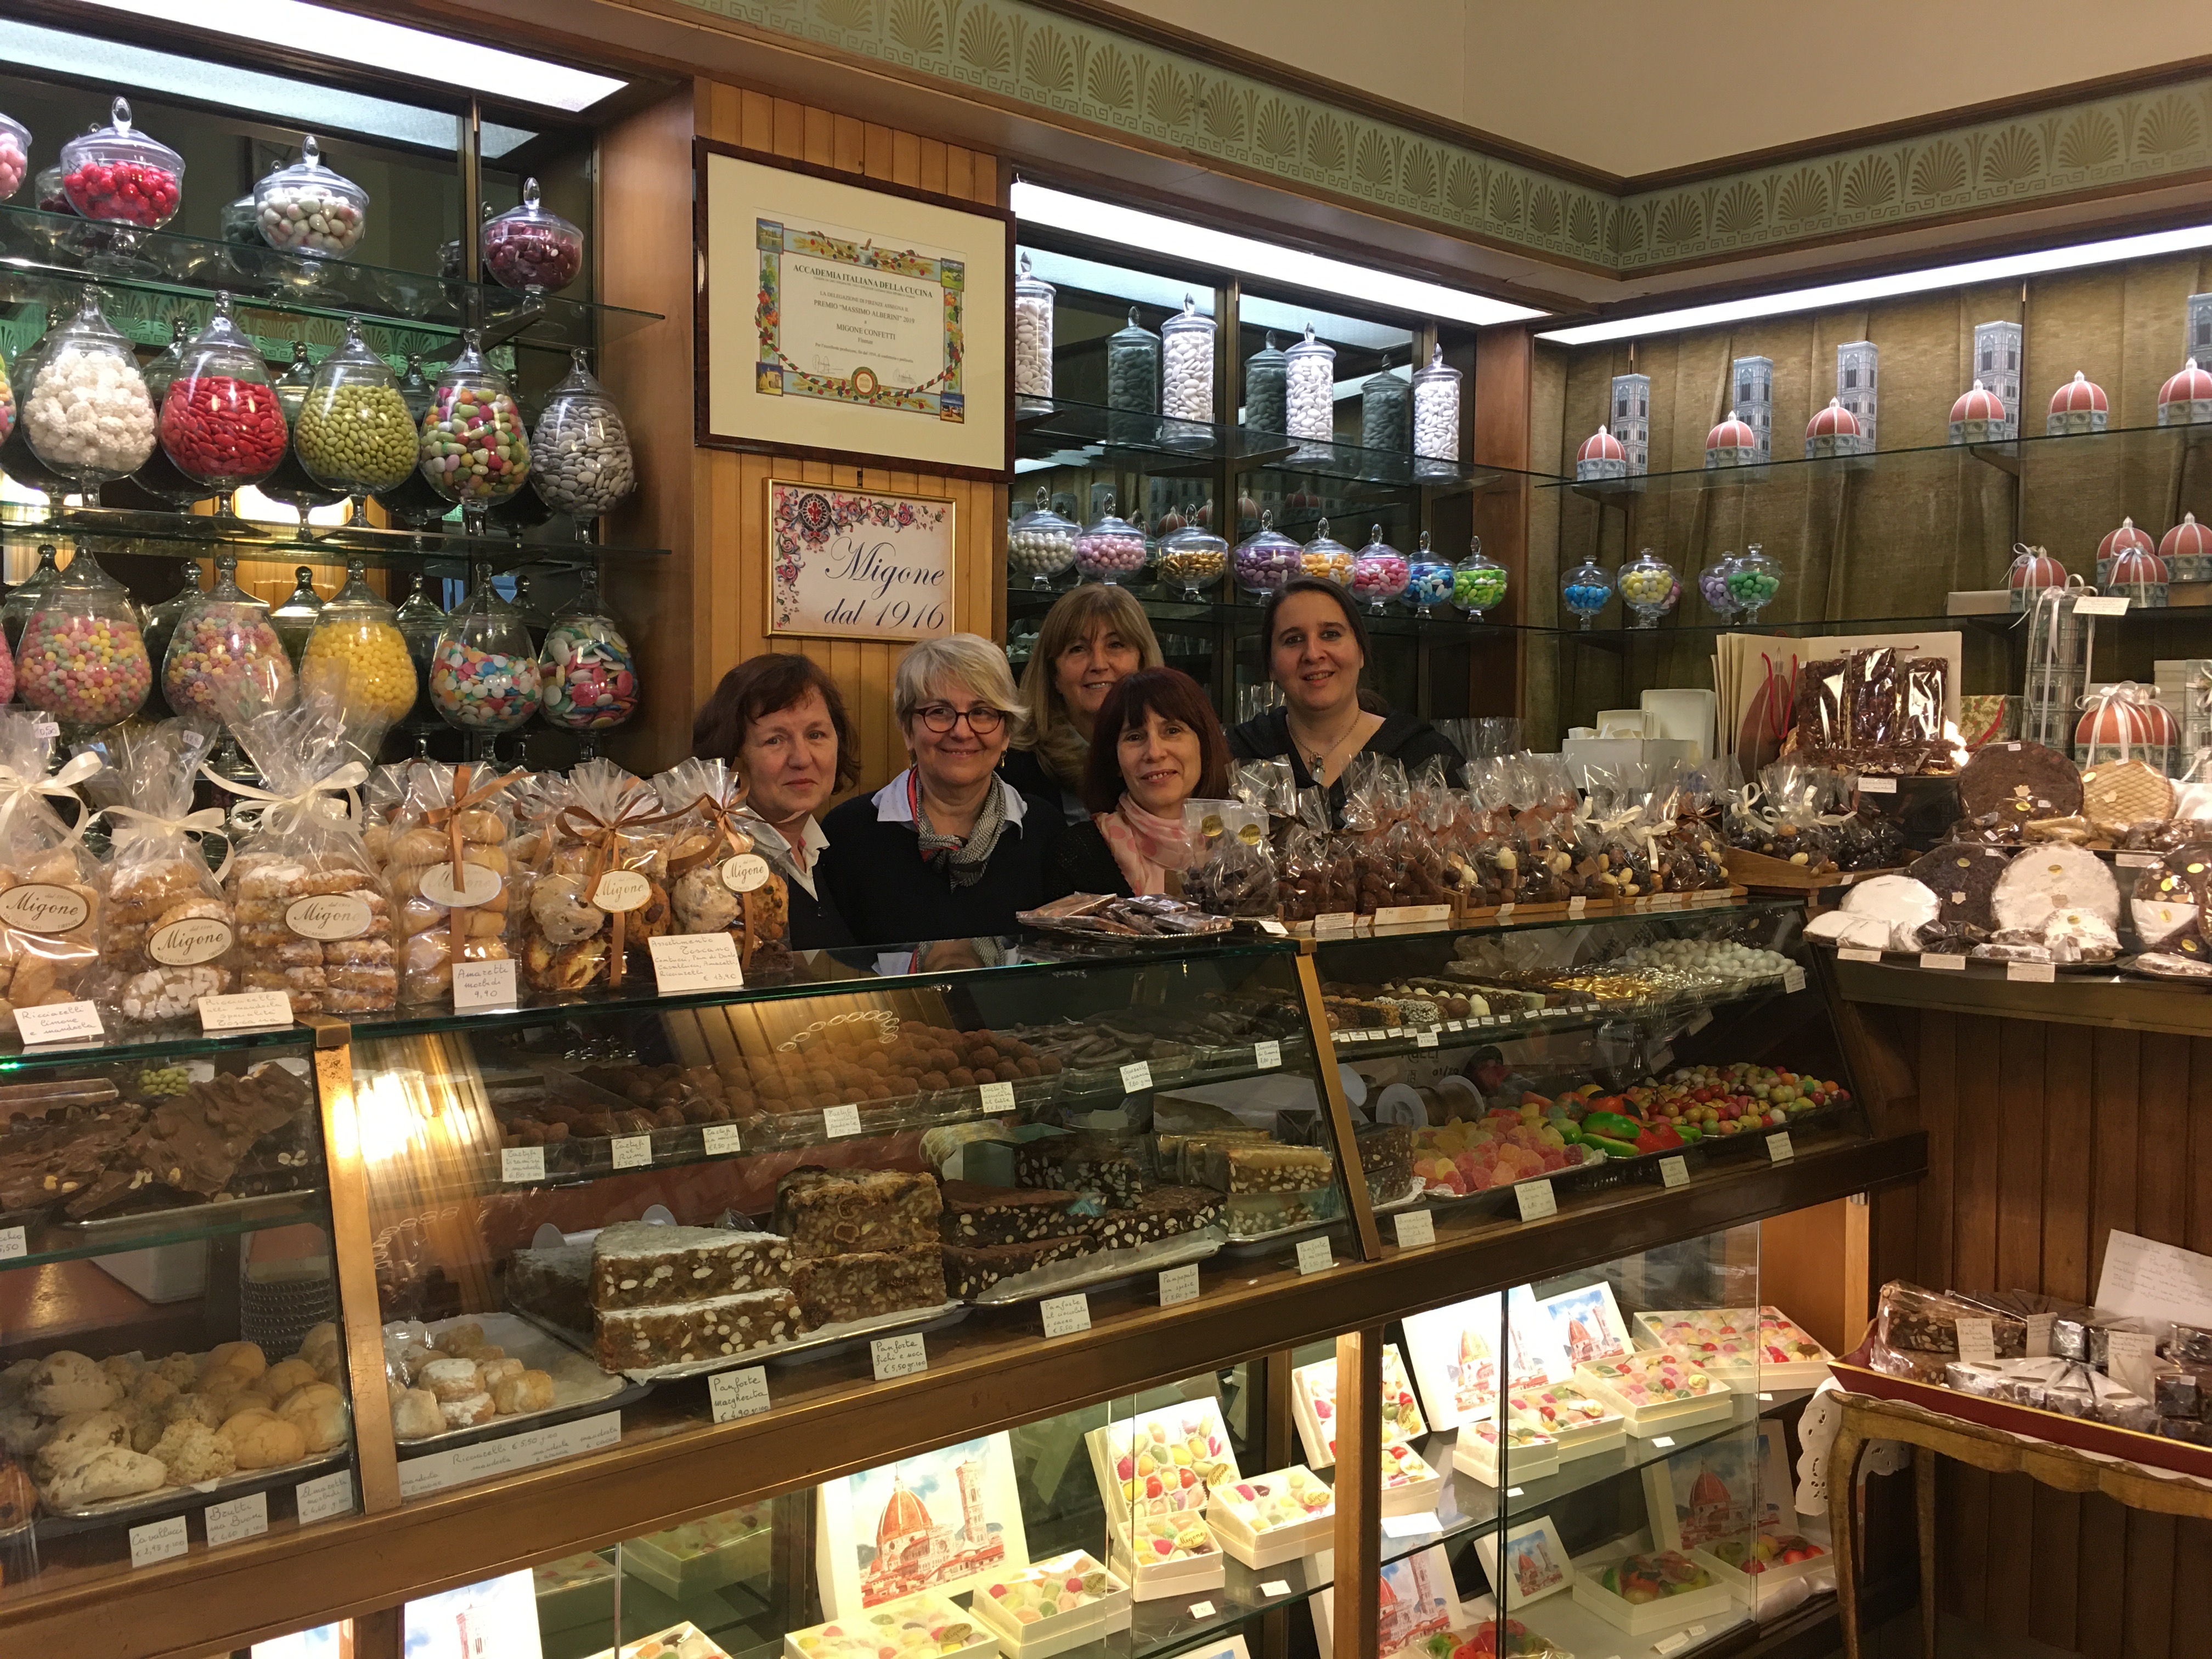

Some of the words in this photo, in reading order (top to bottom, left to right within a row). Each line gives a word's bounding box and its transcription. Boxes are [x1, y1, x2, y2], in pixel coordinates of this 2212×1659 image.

[793, 264, 841, 280] ACCADEMIA
[843, 274, 878, 287] ITALIANA
[879, 281, 904, 292] DELLA
[905, 286, 933, 298] CUCINA
[814, 300, 838, 309] PREMIO
[827, 292, 859, 303] DELEGAZIONE
[865, 300, 883, 308] FIRENZE
[836, 323, 864, 335] MIGONE
[864, 329, 896, 340] CONFETTI
[857, 337, 873, 345] Firenze
[825, 536, 945, 600] Migone
[824, 598, 866, 625] dal
[875, 600, 947, 630] 1916
[726, 861, 764, 884] Migone
[595, 878, 644, 903] Migone
[6, 891, 78, 921] Migone
[2, 912, 10, 921] VIA
[58, 918, 80, 929] FIRENZE
[293, 902, 360, 929] Migone
[157, 928, 224, 956] Migone
[651, 935, 713, 947] Assortimento
[208, 944, 227, 958] FIRENZE
[679, 945, 730, 955] Toscano
[458, 963, 509, 979] Amaretti
[464, 977, 503, 988] morbidi
[205, 994, 276, 1006] Ricciarelli
[474, 990, 498, 999] 9,90
[21, 1006, 84, 1019] Ricciarelli
[234, 1001, 283, 1010] mandorla
[40, 1018, 80, 1027] limone
[43, 1022, 97, 1035] mandorla
[1045, 1299, 1082, 1311] Panforte
[876, 1339, 918, 1354] Panforte
[876, 1352, 896, 1366] fichi
[906, 1346, 923, 1358] noci
[883, 1364, 889, 1373] €
[891, 1363, 906, 1372] 5,50
[713, 1375, 761, 1393] Panforte
[714, 1389, 768, 1409] margherita
[720, 1412, 726, 1421] €
[731, 1409, 749, 1419] 4,90
[579, 1426, 618, 1442] mandorla
[596, 1436, 618, 1446] cacao
[452, 1443, 506, 1465] Ricciarelli
[520, 1437, 538, 1447] 5,50
[470, 1455, 511, 1471] mandorla
[300, 1477, 347, 1499] Amaretti
[210, 1500, 252, 1521] Brutti
[230, 1509, 263, 1527] Buoni
[132, 1523, 184, 1546] Cavallucci
[1178, 1532, 1204, 1546] Migone
[943, 1624, 968, 1641] Migone
